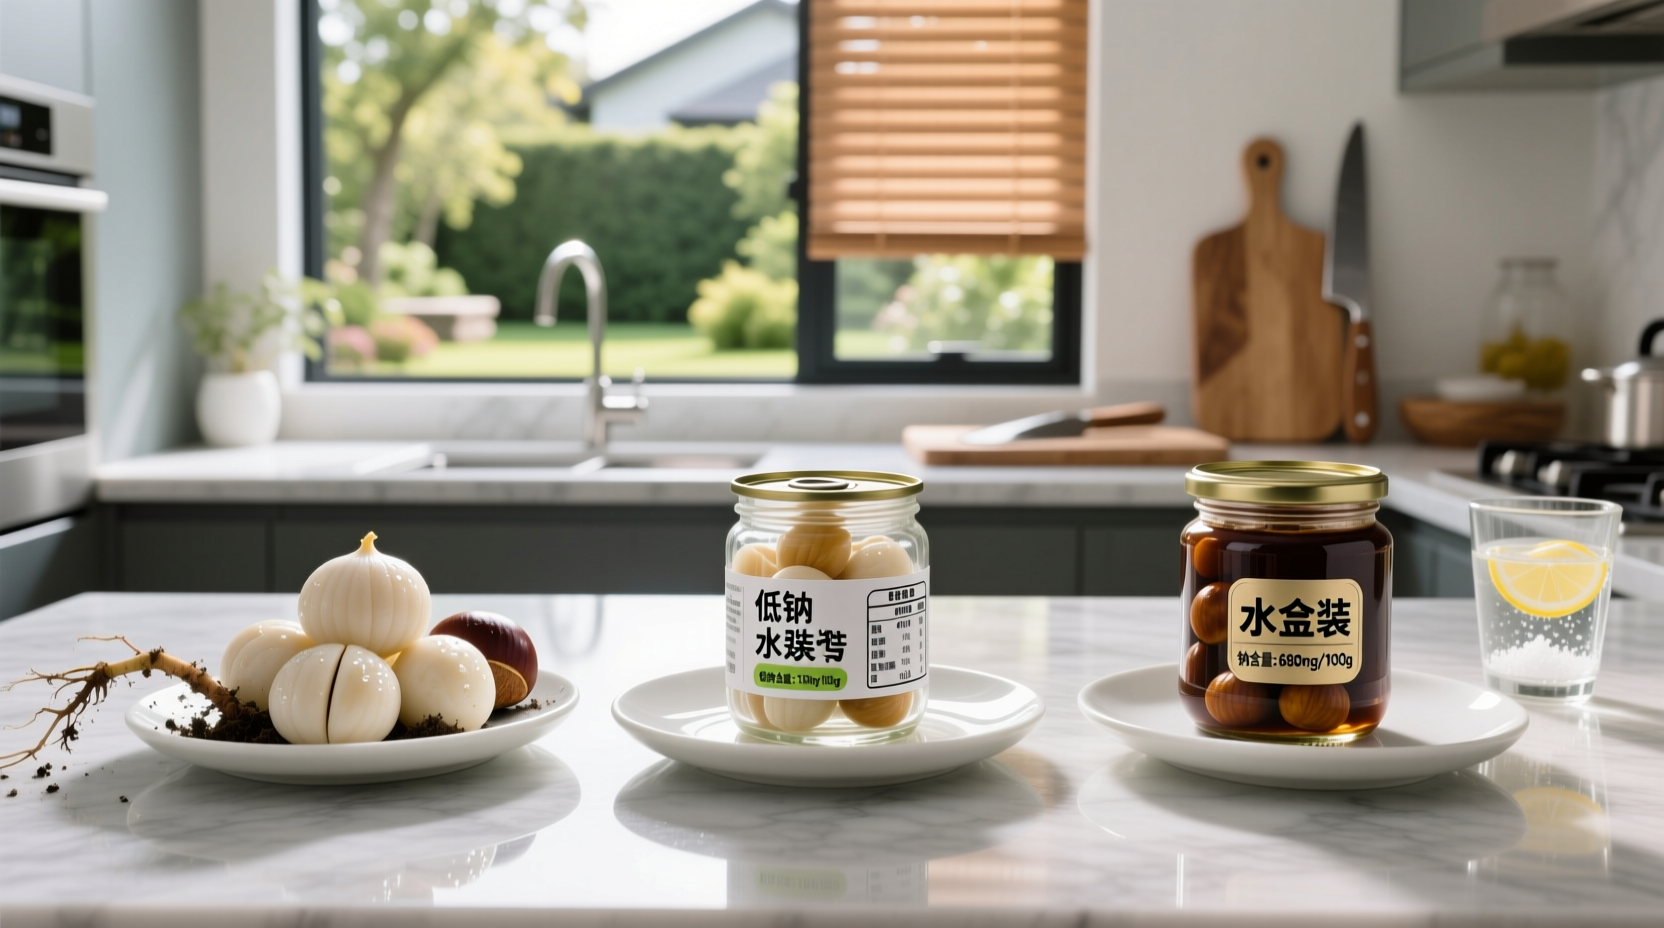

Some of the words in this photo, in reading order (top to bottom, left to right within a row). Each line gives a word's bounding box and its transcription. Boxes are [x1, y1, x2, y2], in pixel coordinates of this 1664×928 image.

[755, 589, 813, 624] 低钠
[1239, 597, 1351, 638] 水盒装
